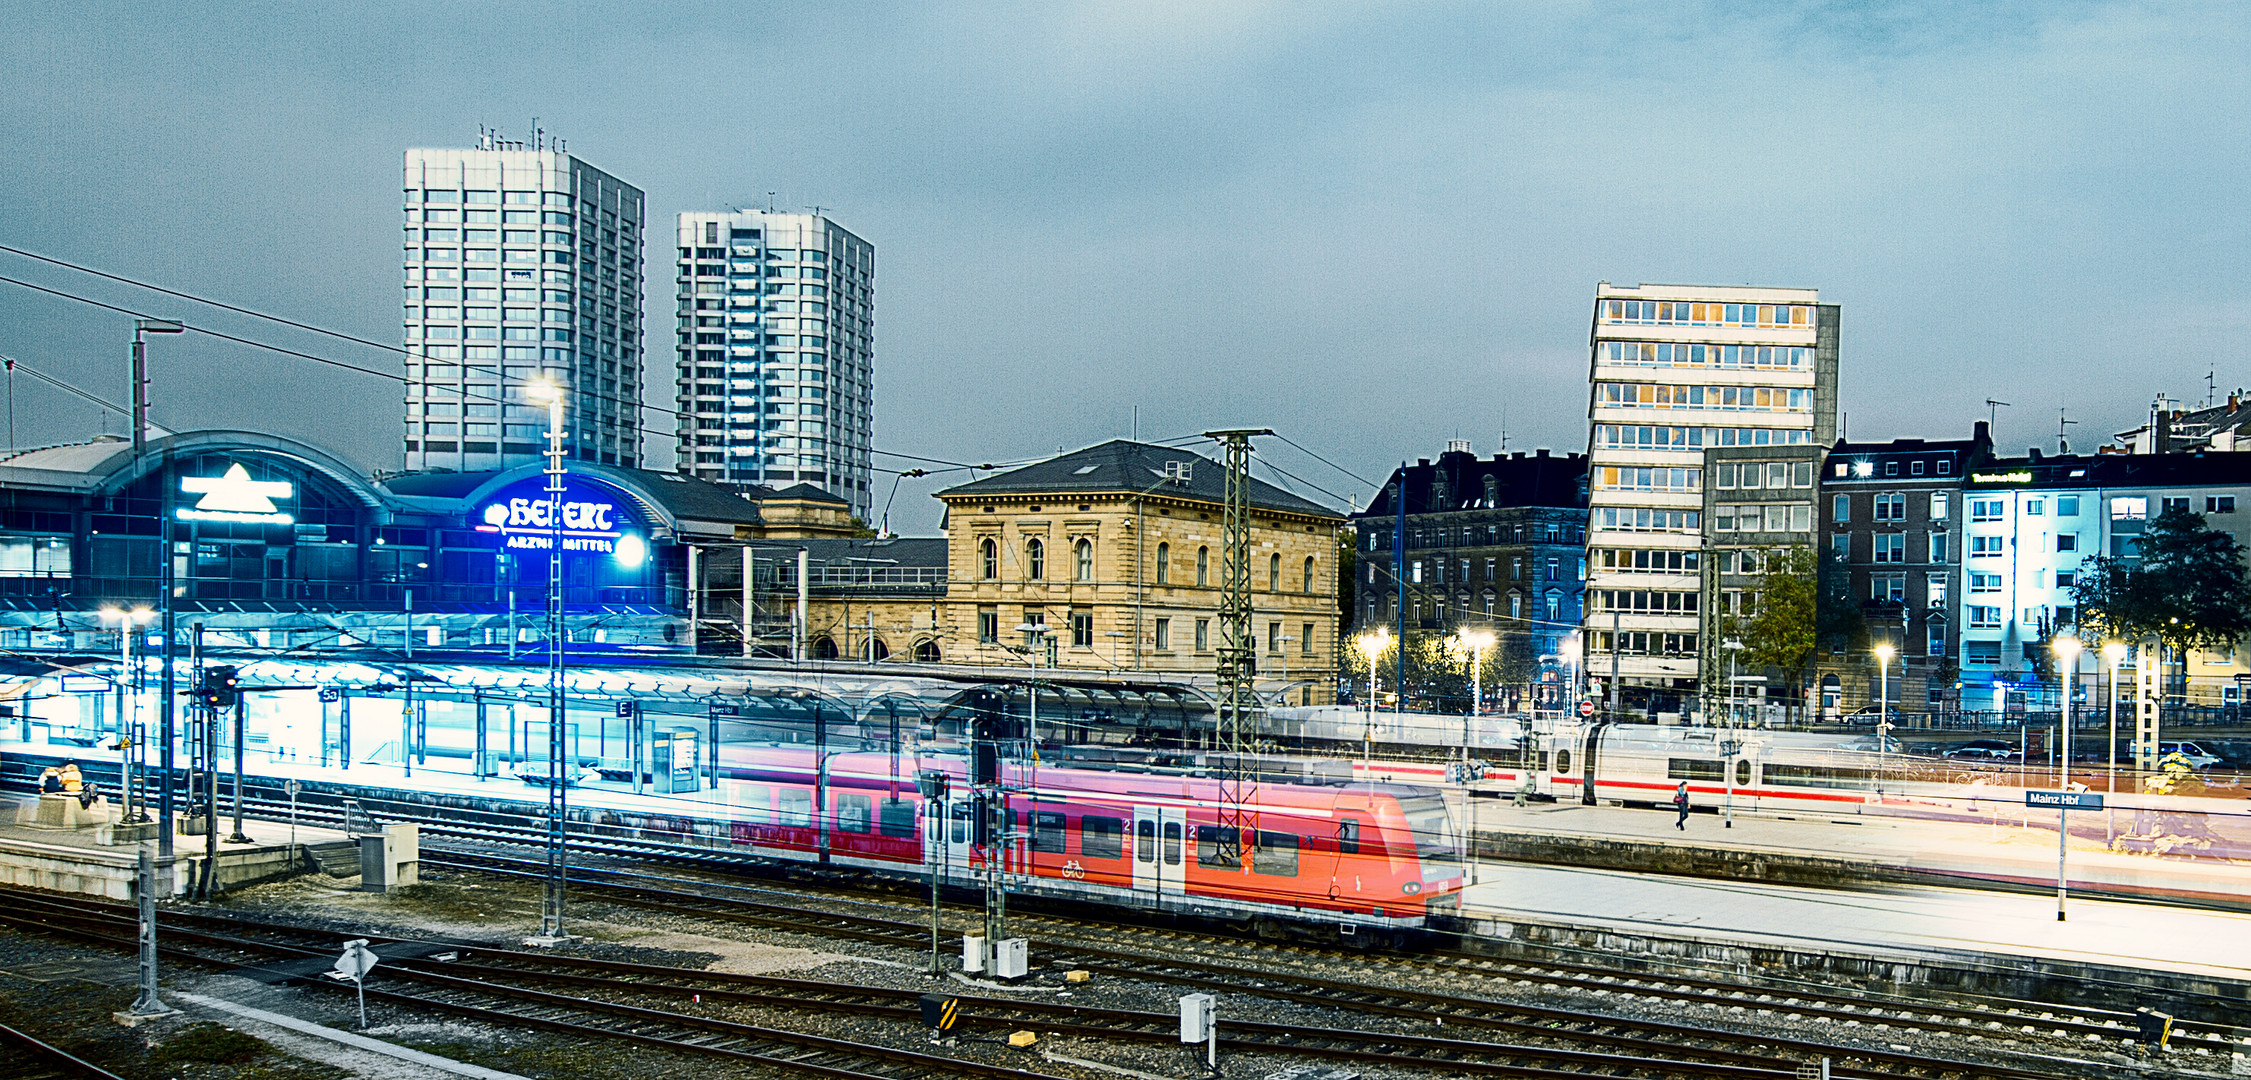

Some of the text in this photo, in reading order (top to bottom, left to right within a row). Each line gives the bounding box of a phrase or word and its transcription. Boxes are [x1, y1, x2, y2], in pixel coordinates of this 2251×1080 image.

[507, 536, 612, 553] ARZNMITTEL
[323, 689, 337, 700] 5a
[619, 702, 627, 714] E
[2030, 793, 2080, 805] Mainz Hbf
[1124, 819, 1131, 831] 2
[1188, 825, 1196, 838] 2
